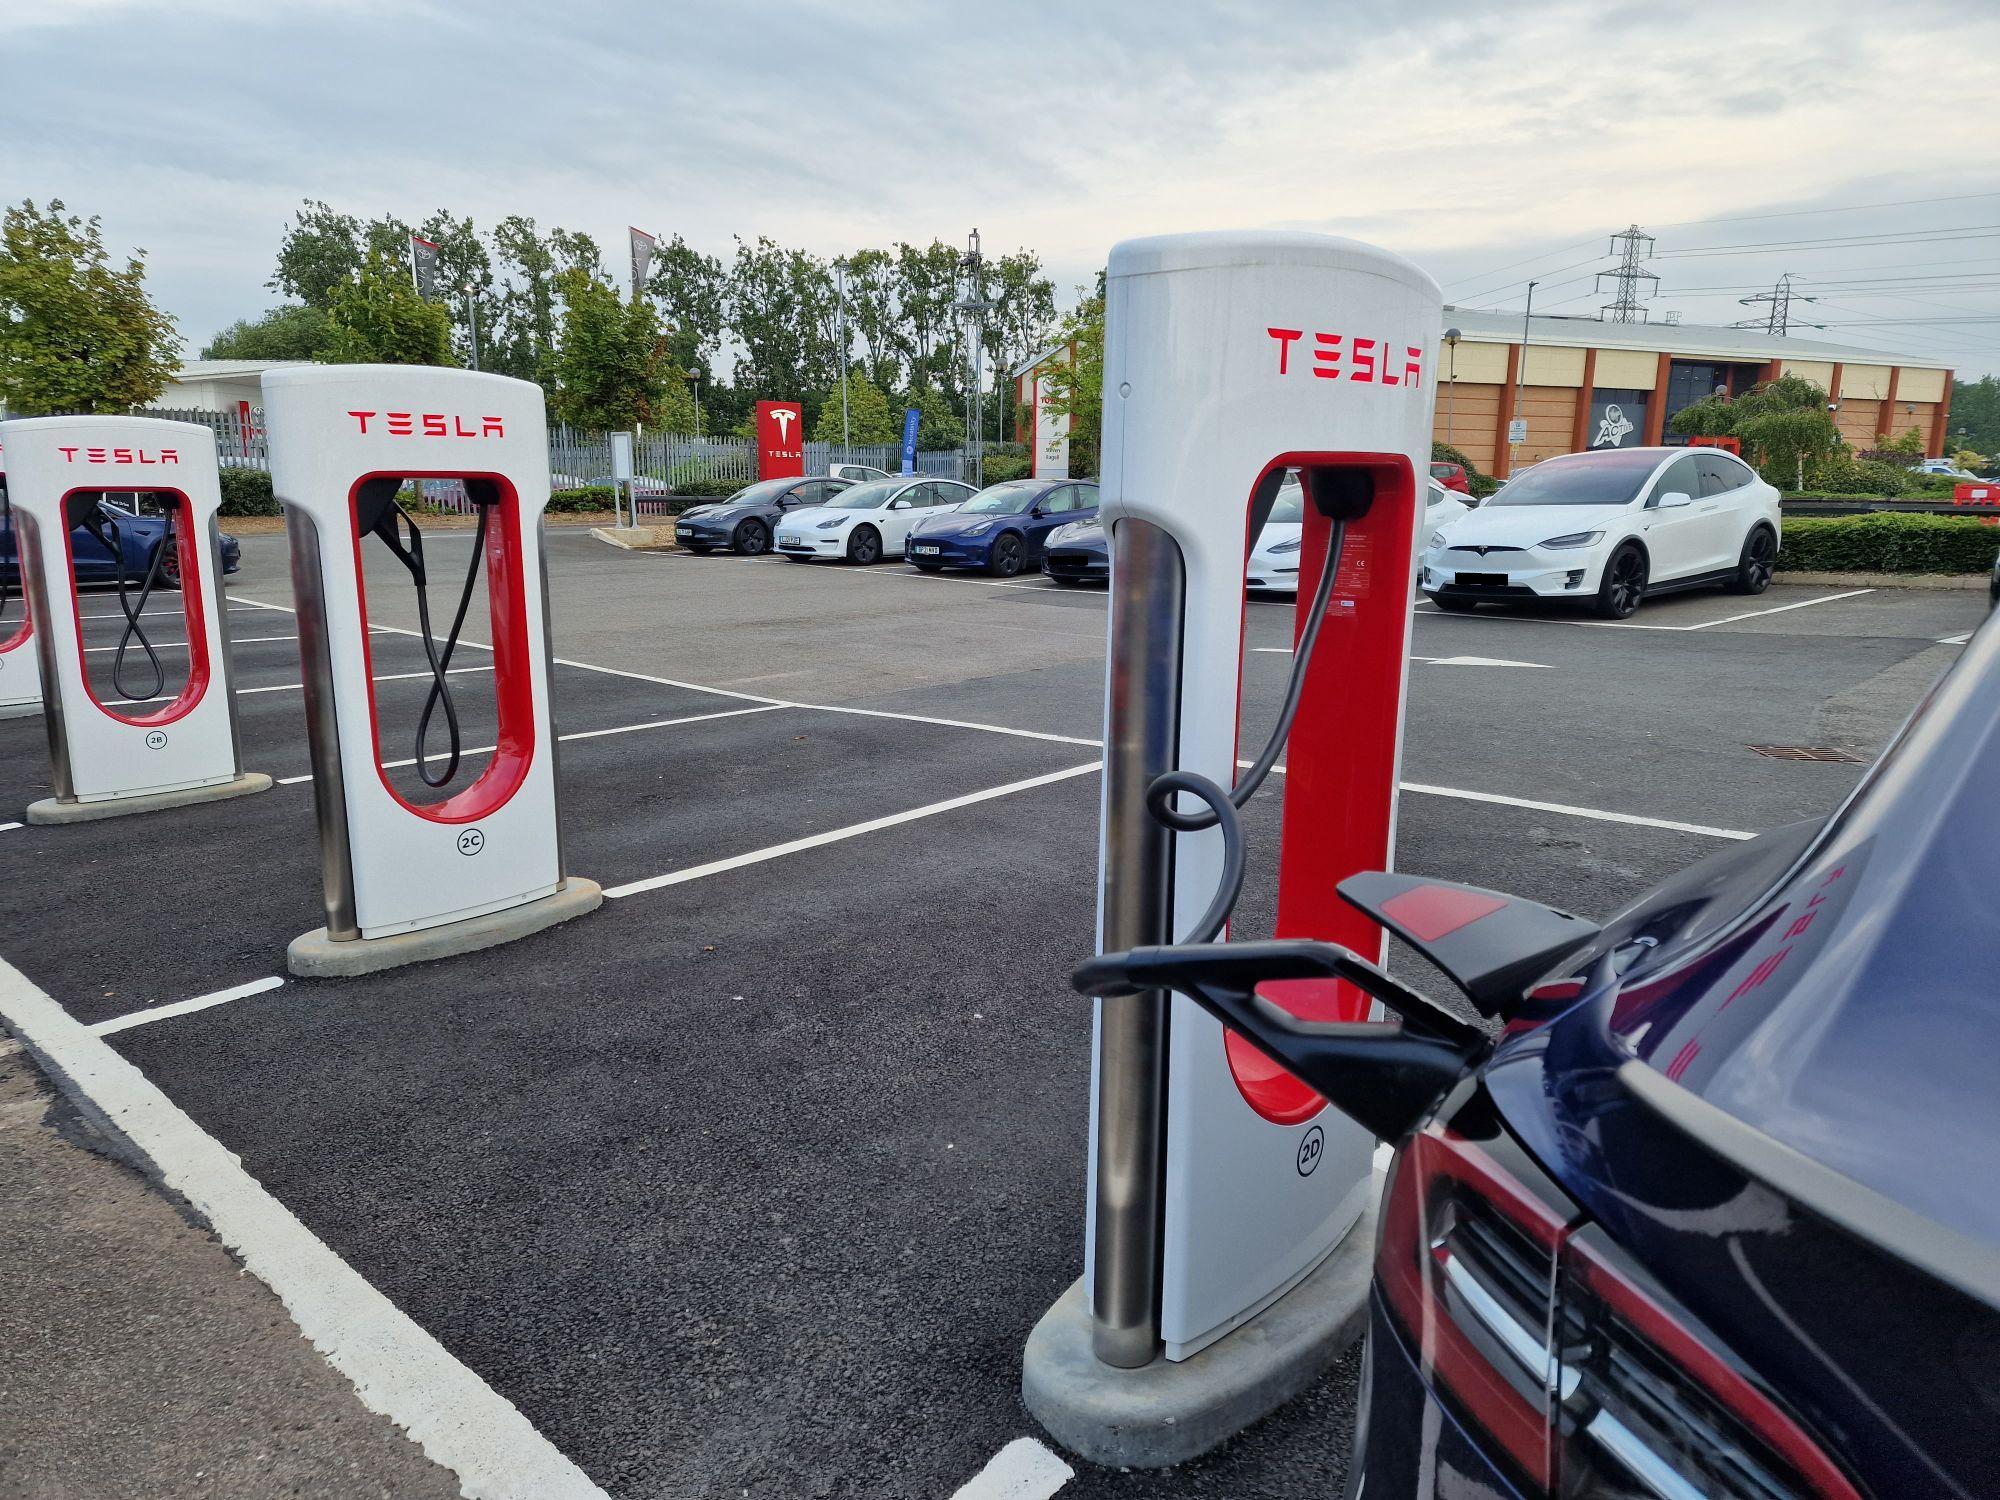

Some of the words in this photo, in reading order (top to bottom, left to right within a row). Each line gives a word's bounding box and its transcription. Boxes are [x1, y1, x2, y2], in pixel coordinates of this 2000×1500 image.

[1267, 327, 1423, 389] TESLA
[347, 411, 504, 438] TESLA
[57, 447, 179, 464] TESLA
[768, 450, 801, 458] TESLA
[151, 736, 163, 744] 2B
[462, 835, 480, 849] 2C
[1301, 1139, 1320, 1164] 2D
